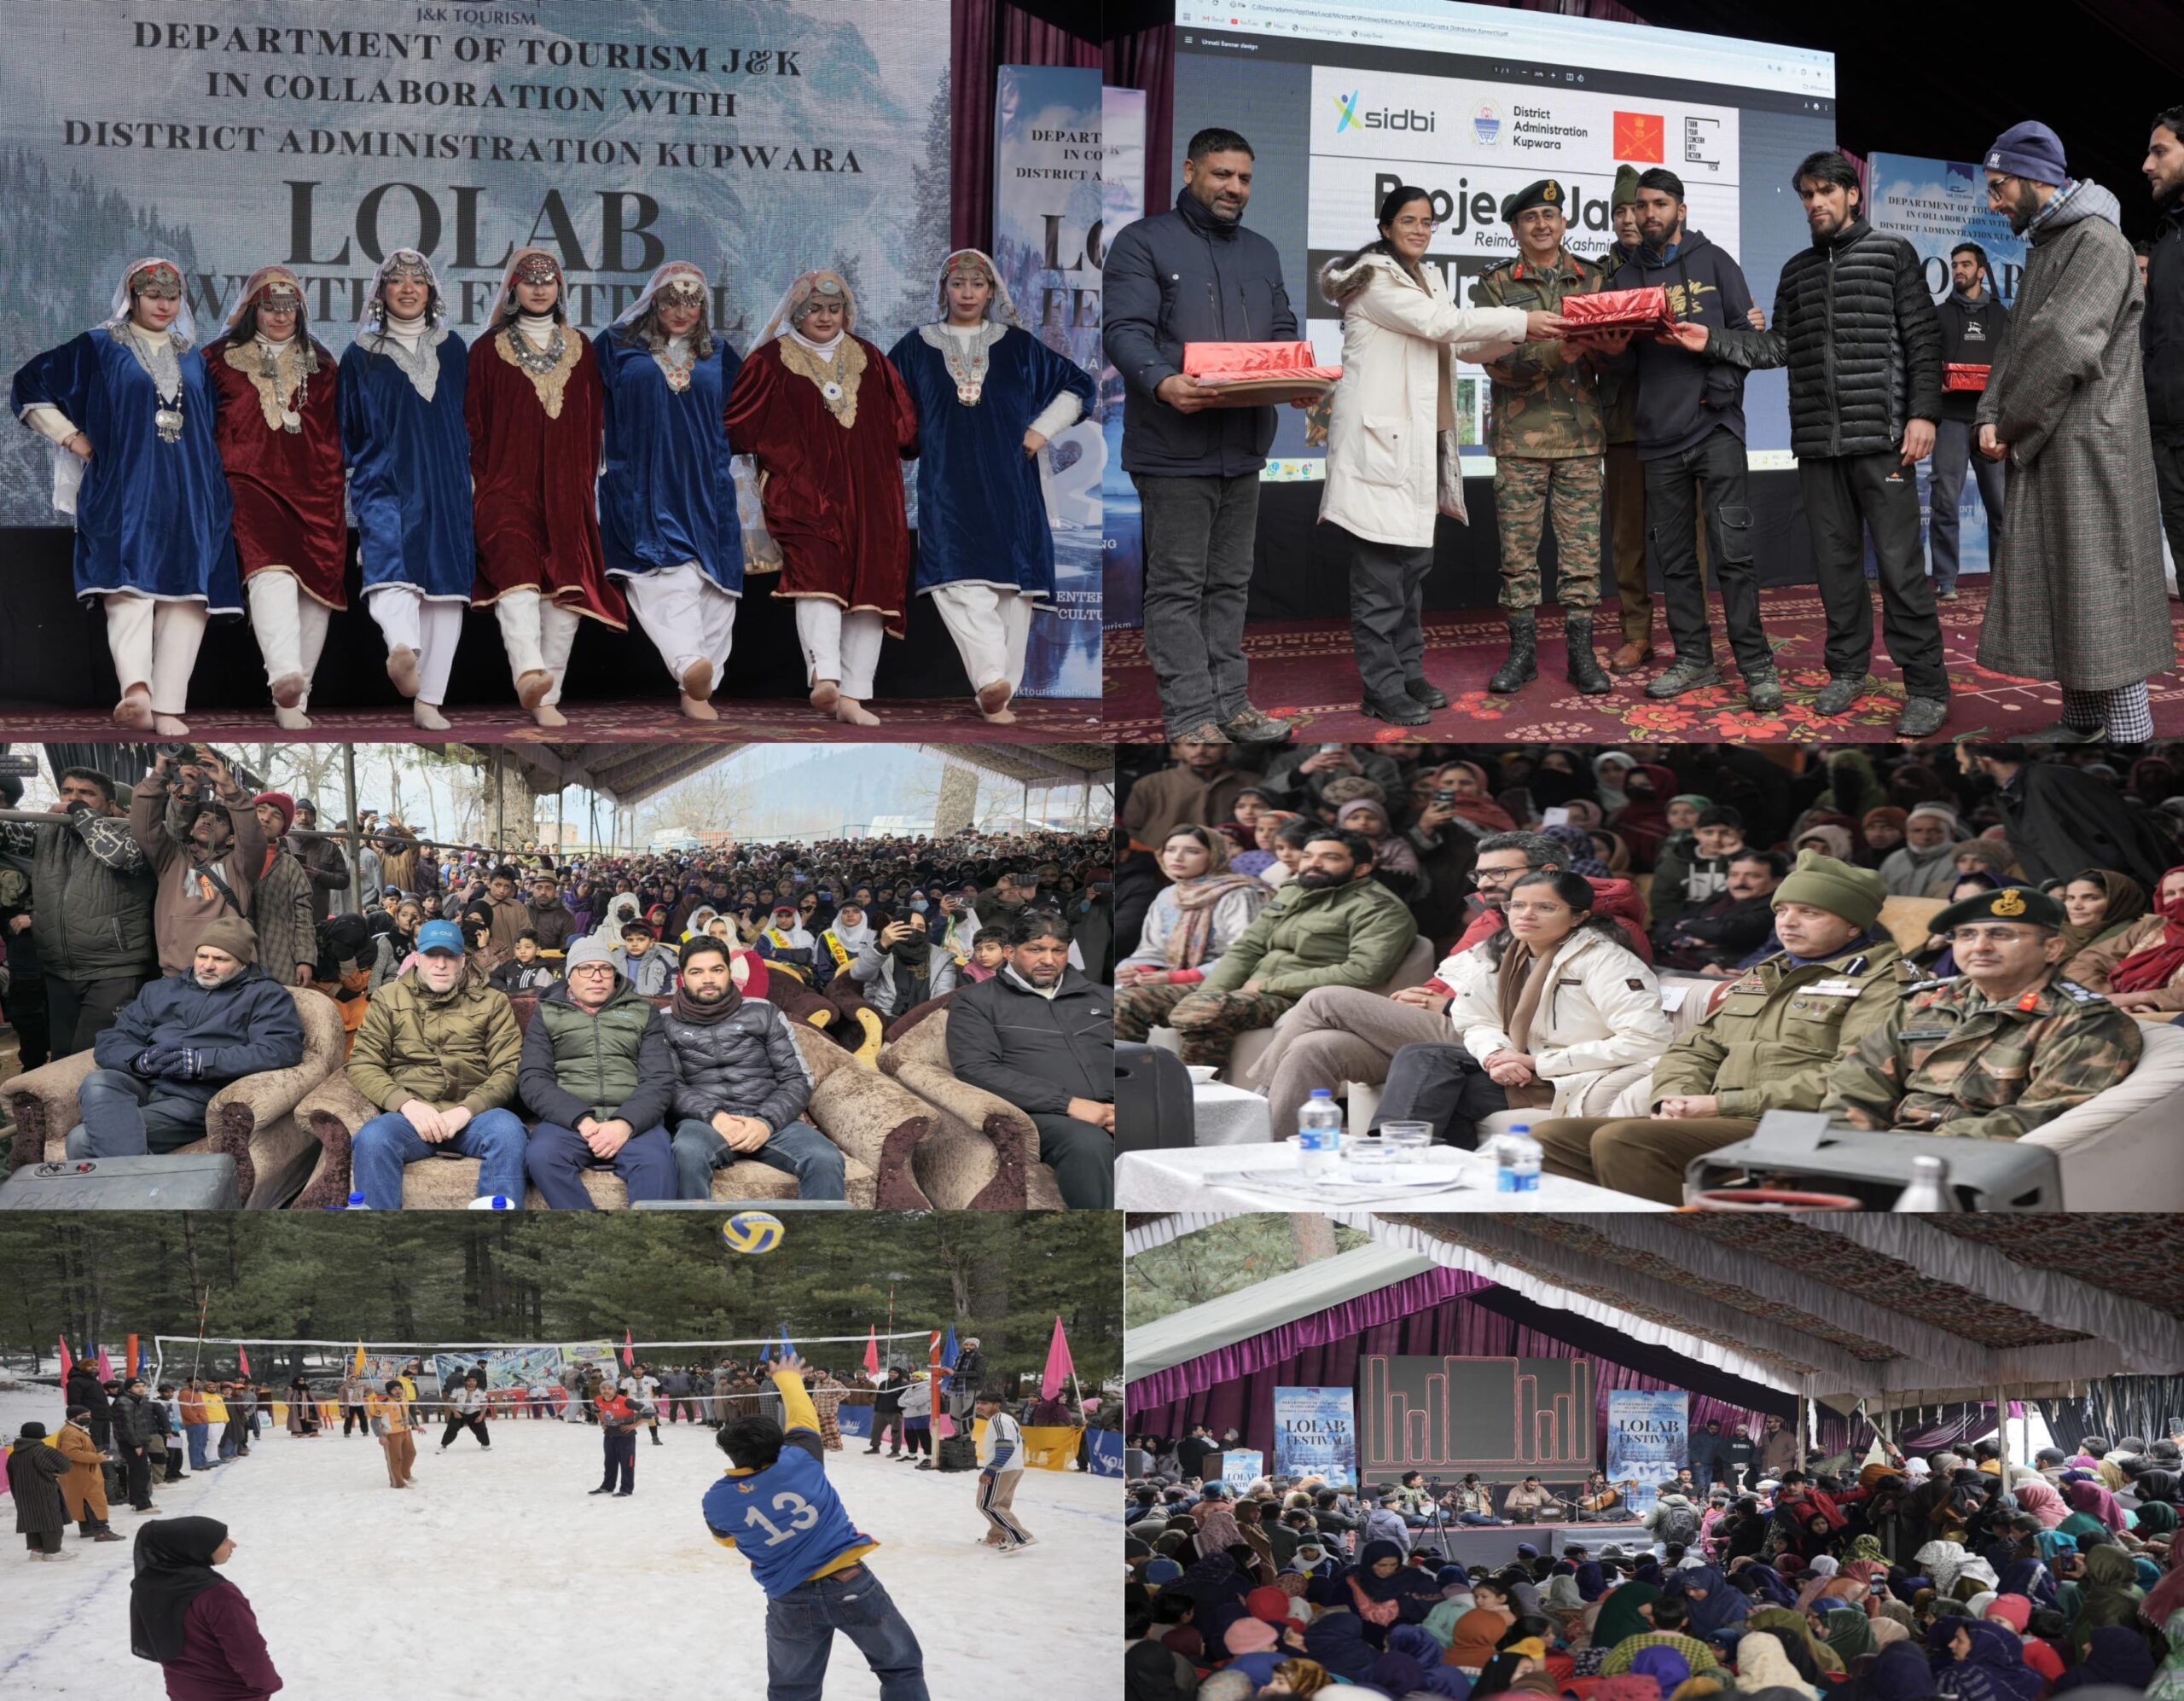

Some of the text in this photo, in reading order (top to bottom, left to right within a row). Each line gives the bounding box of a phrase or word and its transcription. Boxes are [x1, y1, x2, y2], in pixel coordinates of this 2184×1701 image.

[416, 8, 537, 26] J&K TOURISM
[133, 20, 802, 77] DEPARTMENT OF TOURISM J&K
[206, 72, 737, 118] IN COLLABORATION WITH
[1365, 107, 1435, 133] sidbi
[1513, 105, 1551, 120] District
[1031, 130, 1102, 143] DEPART
[1513, 121, 1589, 138] Administration
[63, 119, 863, 173] DISTRICT ADMINISTRATION KUPWARA
[1513, 136, 1562, 151] Kupwara
[1063, 148, 1080, 160] IN
[1015, 167, 1088, 181] DISTRICT
[1888, 196, 1956, 212] DEPARTMENT
[282, 179, 665, 273] LOLAB
[1879, 221, 1920, 232] DISTRICT
[1918, 212, 1987, 226] COLLABORATION
[1286, 1419, 1345, 1433] LOLAB
[1620, 1419, 1679, 1433] LOLAB
[1287, 1435, 1346, 1446] FESTIVAL
[1618, 1434, 1679, 1444] FESTIVAL
[1616, 1460, 1679, 1483] 2025
[744, 1491, 819, 1547] 13
